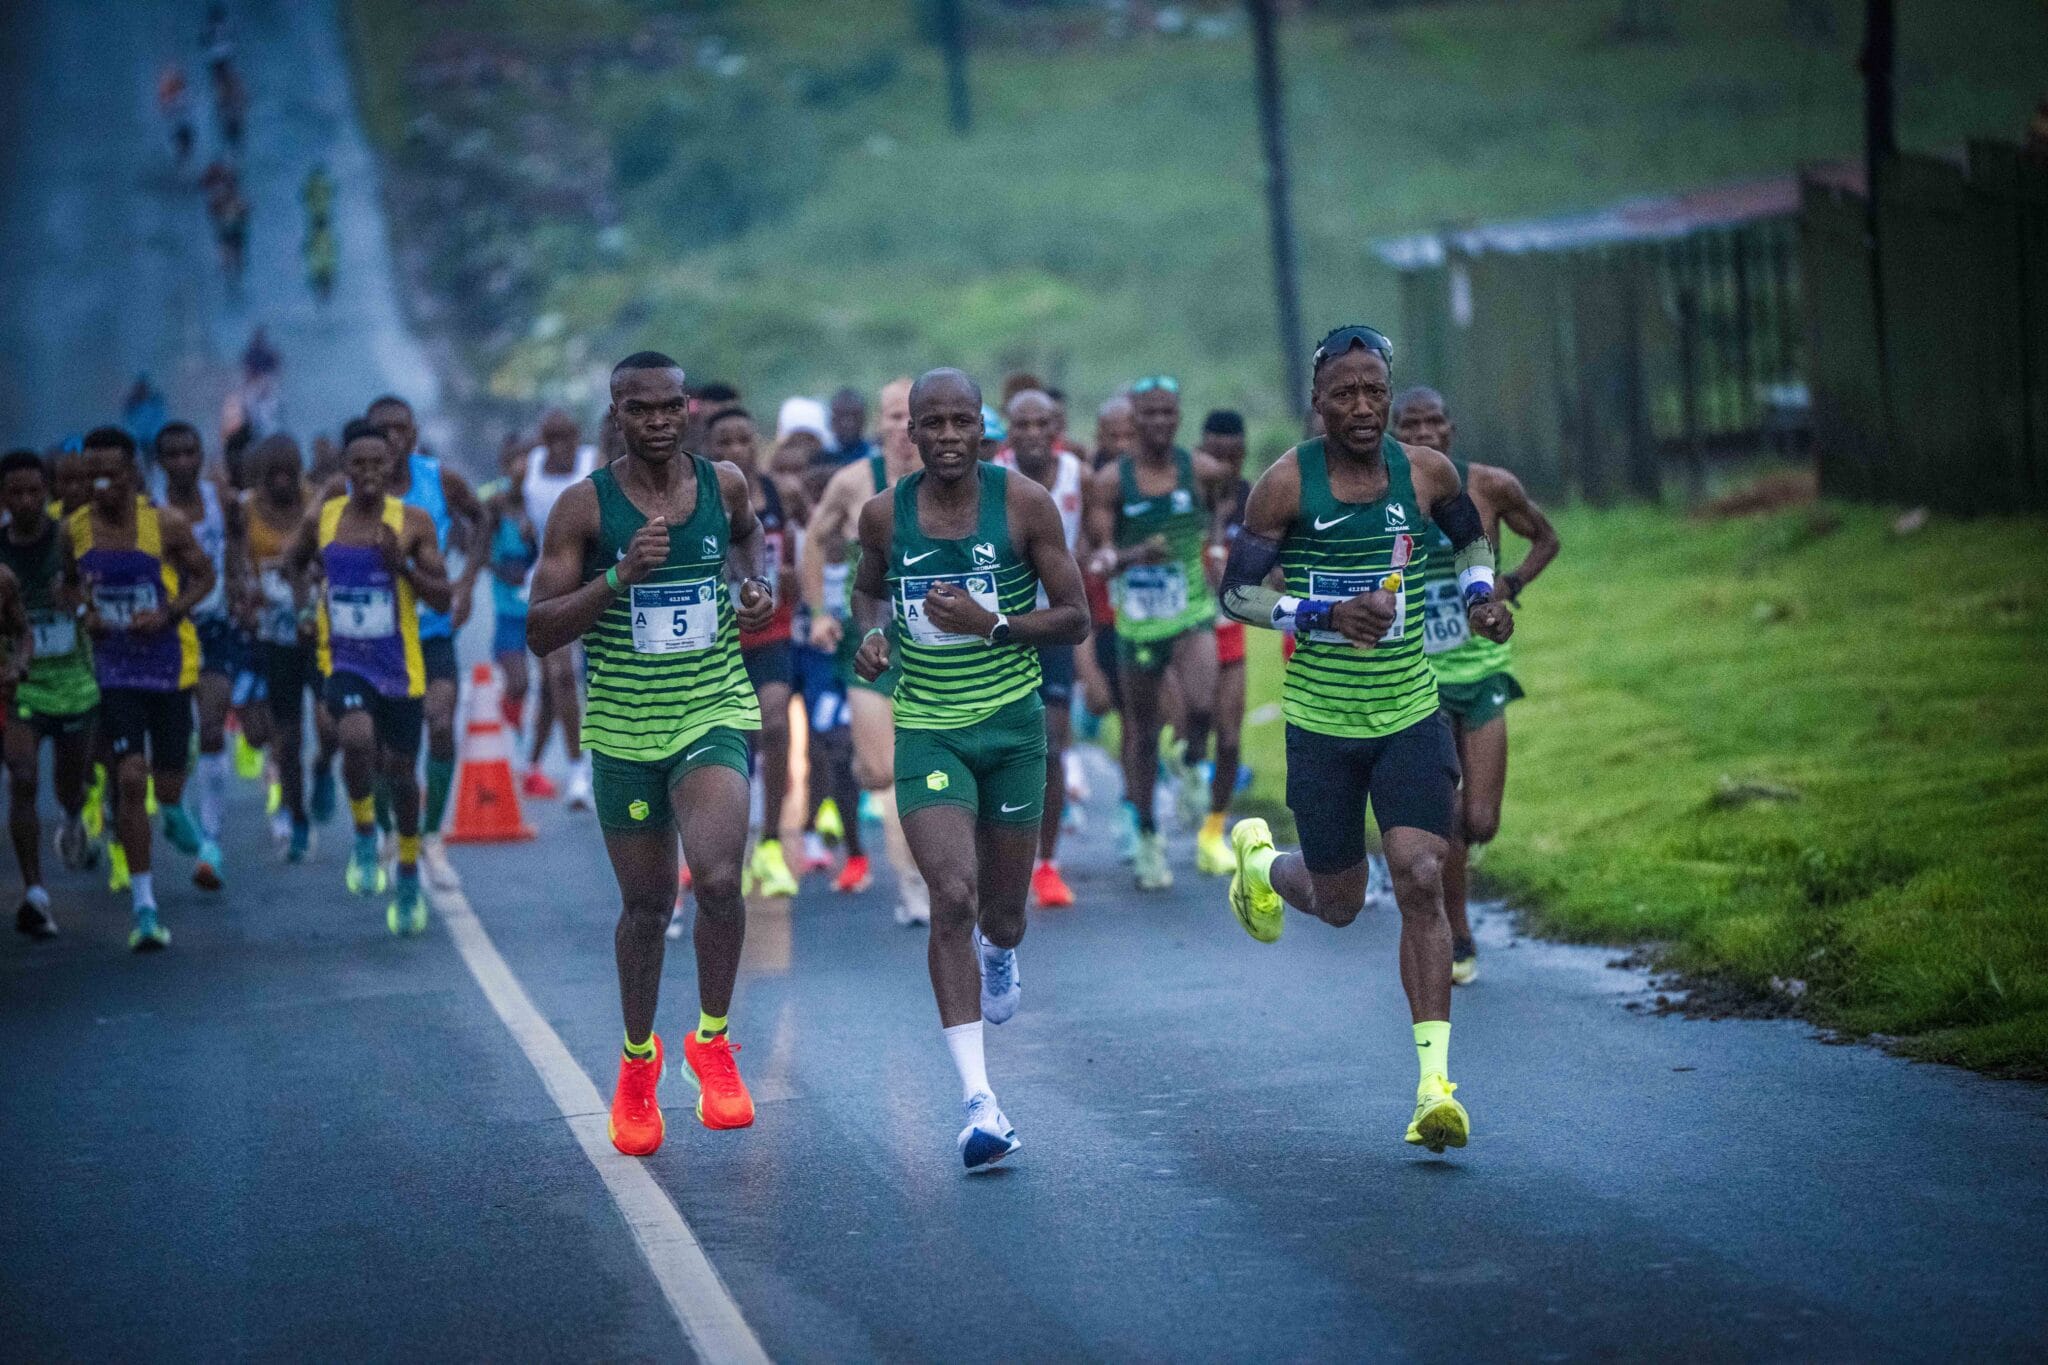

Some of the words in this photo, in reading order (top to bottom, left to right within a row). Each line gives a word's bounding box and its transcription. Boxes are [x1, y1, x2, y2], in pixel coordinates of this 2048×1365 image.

[908, 604, 919, 618] A
[635, 612, 647, 626] A
[672, 609, 688, 637] 5
